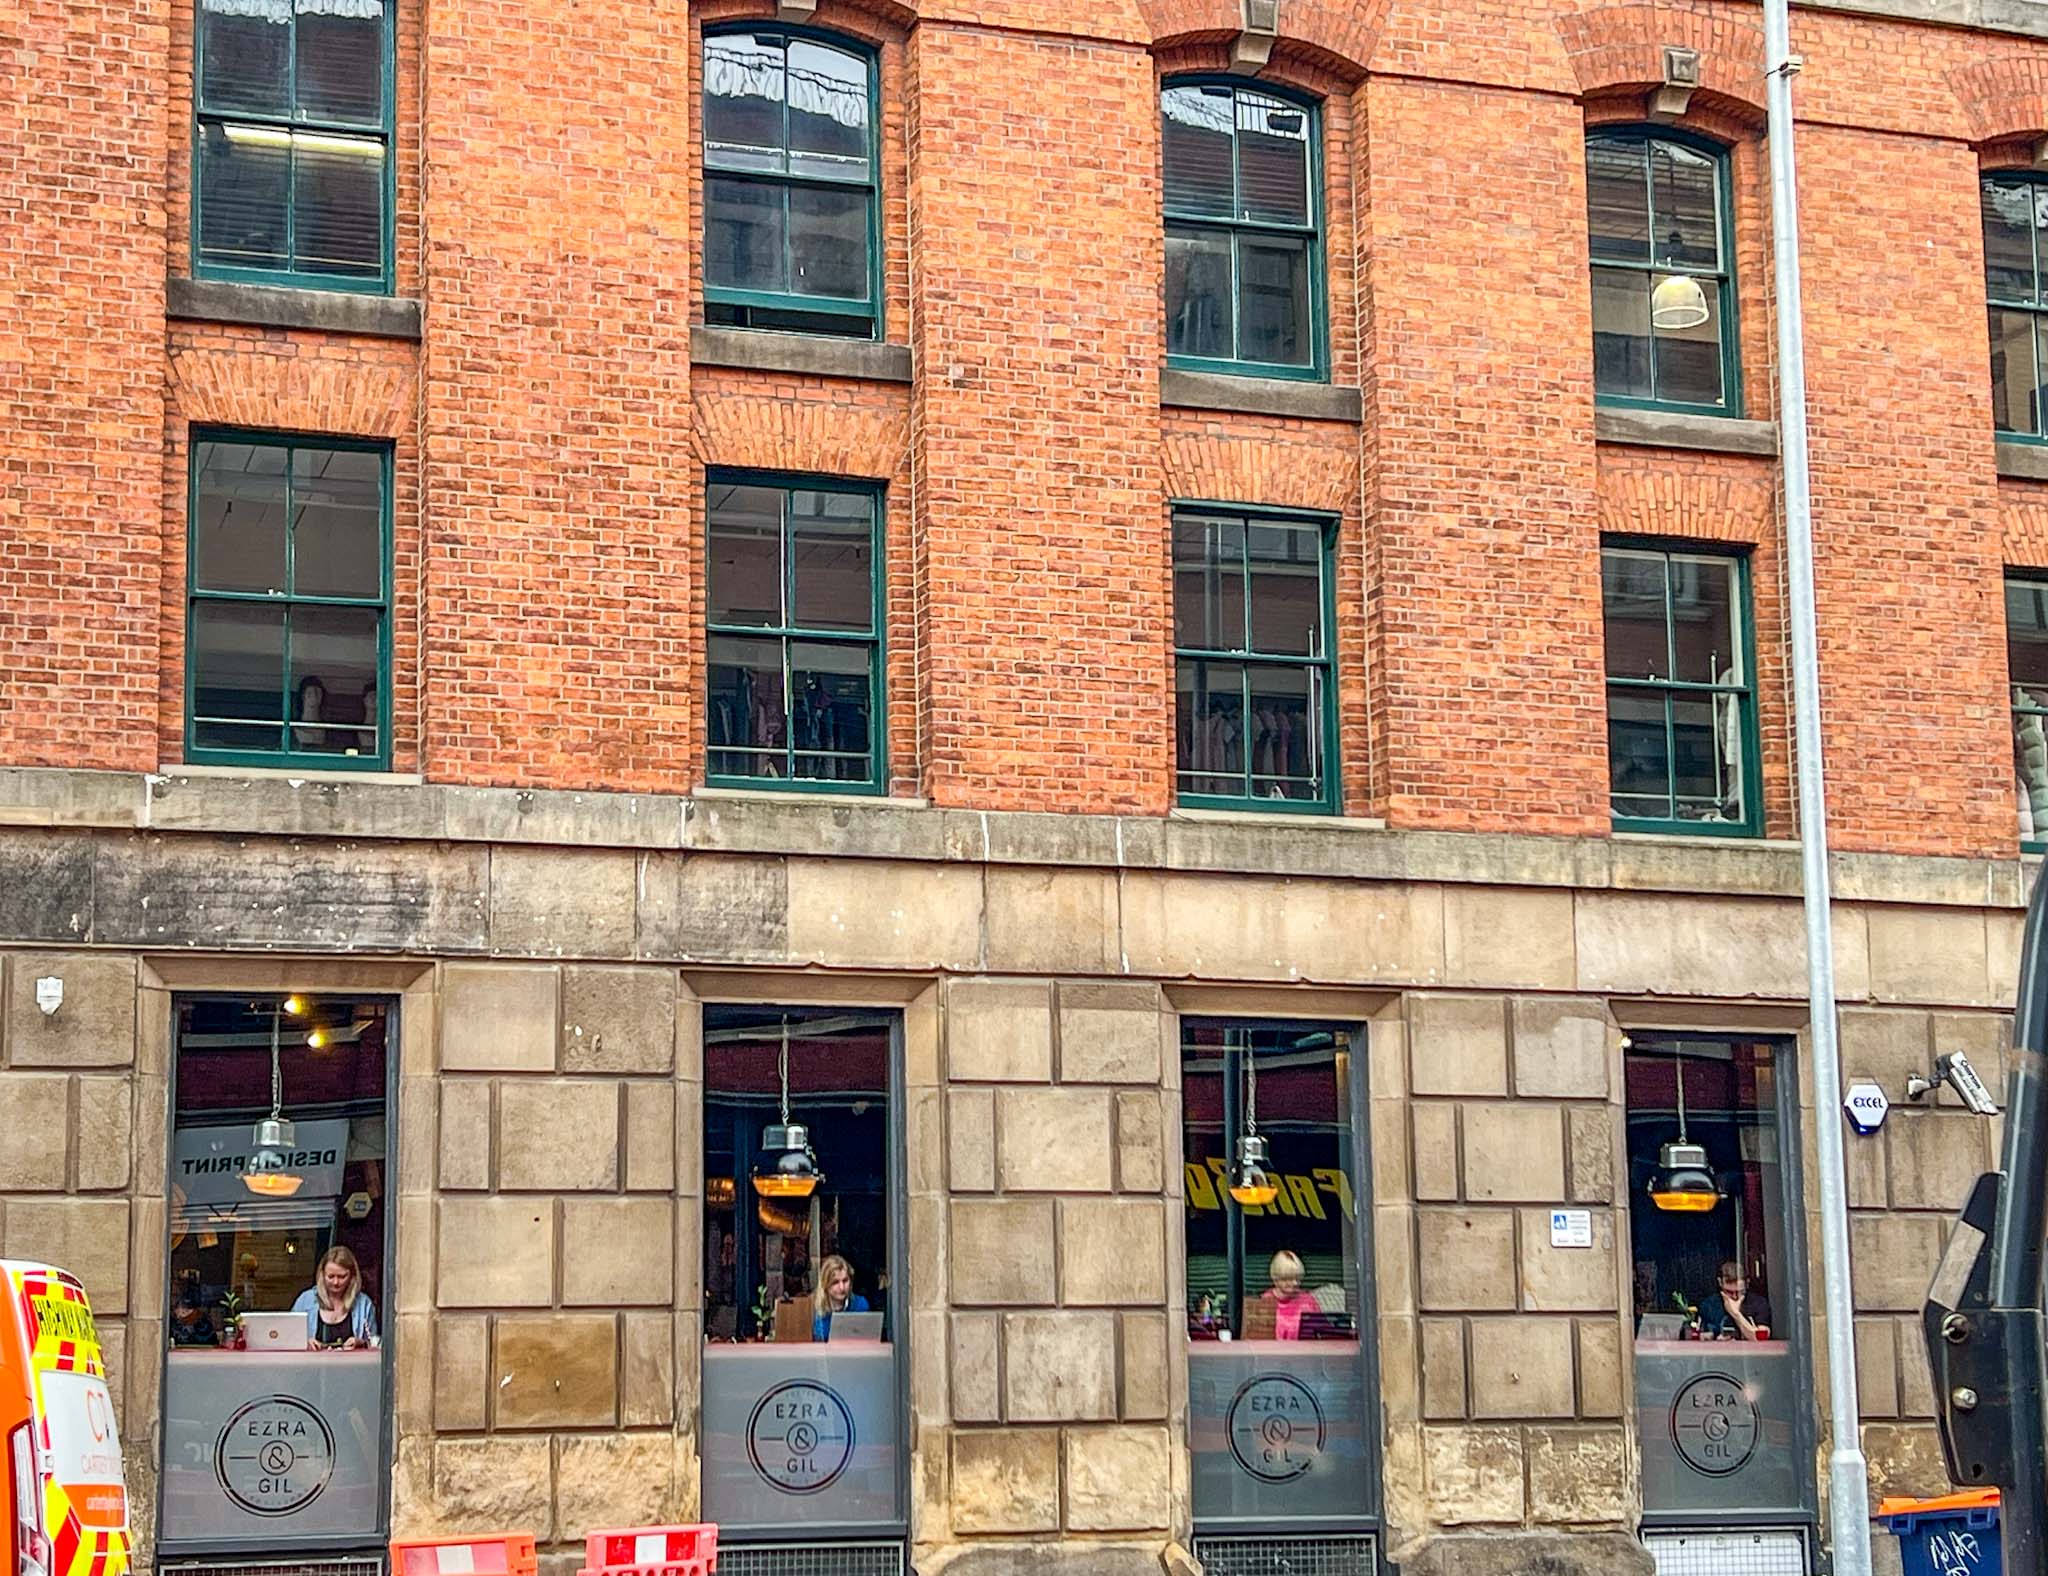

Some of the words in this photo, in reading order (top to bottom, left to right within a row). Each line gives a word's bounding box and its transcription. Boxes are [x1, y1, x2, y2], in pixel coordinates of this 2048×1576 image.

[1853, 1096, 1884, 1109] EXCEL
[1251, 1395, 1301, 1412] EZRA
[1692, 1394, 1738, 1408] EZRA
[776, 1403, 828, 1419] EZRA
[248, 1421, 306, 1436] EZRA
[795, 1427, 811, 1450] &
[268, 1446, 286, 1469] &
[1703, 1444, 1732, 1458] GIL
[787, 1458, 817, 1473] GIL
[258, 1479, 293, 1494] GIL
